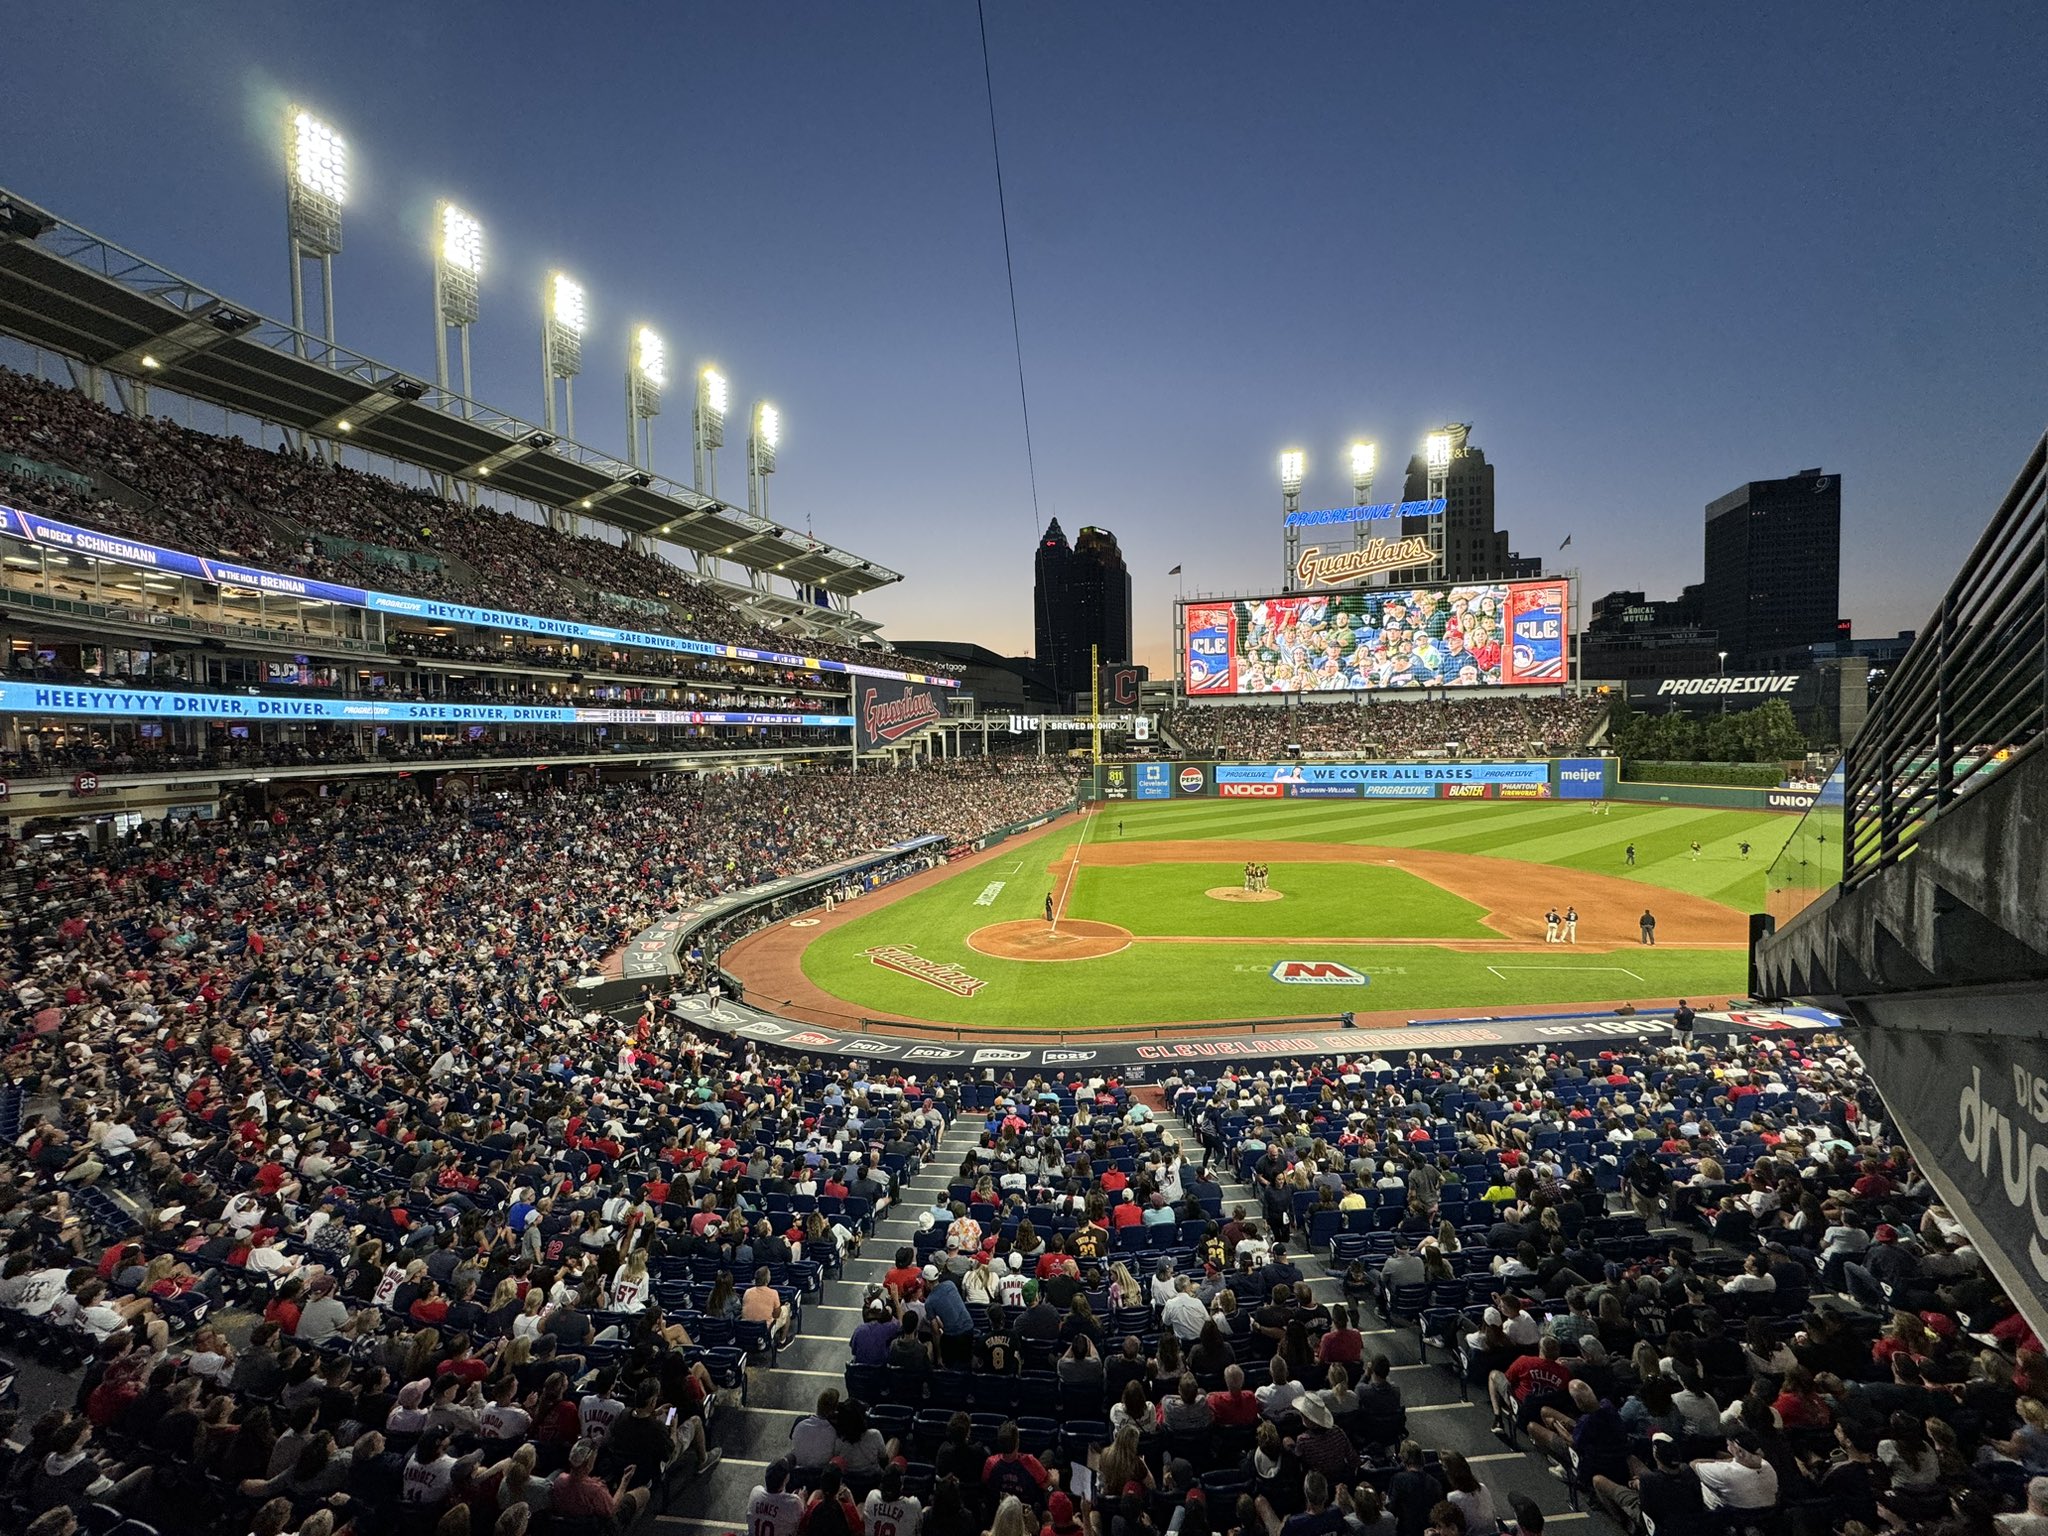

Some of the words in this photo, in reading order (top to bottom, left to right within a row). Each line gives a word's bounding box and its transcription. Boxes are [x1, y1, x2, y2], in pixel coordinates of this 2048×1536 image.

[1284, 503, 1395, 528] PROGRESSIVE
[1396, 498, 1448, 518] FIELD
[37, 526, 50, 538] ON
[50, 529, 73, 544] DECK
[76, 533, 157, 563] SCHNEEMANN
[1296, 537, 1437, 589] Guardians
[226, 572, 240, 582] THE
[240, 574, 258, 585] HOLE
[260, 576, 305, 593] BRENNAN
[1623, 614, 1655, 623] MUTUAL
[428, 604, 476, 620] HEYYY
[482, 612, 534, 630] DRIVER,
[537, 617, 584, 635] DRIVER.
[620, 633, 642, 643] SAFE
[645, 636, 680, 649] DRIVER,
[681, 642, 712, 653] DRIVER!
[1516, 620, 1558, 639] CLE
[1193, 637, 1226, 655] CLE
[937, 662, 967, 672] ortgage
[1114, 669, 1137, 705] C
[1657, 676, 1800, 696] PROGRESSIVE
[36, 688, 163, 710] HEEEYYYYY
[173, 697, 249, 716] DRIVER,
[258, 701, 331, 715] DRIVER.
[409, 706, 447, 718] SAFE
[452, 707, 508, 720] DRIVER,
[513, 708, 562, 719] DRIVER!
[863, 686, 942, 744] Guardians
[1009, 715, 1039, 734] Lite
[1051, 722, 1086, 730] BREWED
[1097, 722, 1117, 730] OHIO
[80, 778, 96, 789] 25
[1109, 771, 1122, 780] 811
[1314, 770, 1335, 779] WE
[1340, 770, 1388, 779] COVER
[1393, 770, 1420, 779] ALL
[1425, 770, 1473, 779] BASES
[1485, 770, 1534, 778] PROGRESSIVE
[1561, 768, 1602, 783] meijer
[1224, 785, 1278, 795] NOCO
[1366, 786, 1431, 795] PROGRESSIVE
[1449, 785, 1485, 796] BLASTER
[1285, 976, 1362, 984] Marathon
[1535, 1025, 1592, 1036] EST.
[1582, 1019, 1675, 1034] 1901
[851, 1042, 888, 1051] 2017
[1136, 1038, 1319, 1059] CLEVELAND
[1322, 1027, 1504, 1052] GUARDIANS
[1047, 1052, 1088, 1060] 2022
[545, 1240, 564, 1260] 12
[376, 1278, 393, 1300] 12
[617, 1284, 639, 1304] 57
[1009, 1293, 1021, 1307] 11
[1649, 1318, 1665, 1334] 11
[992, 1347, 1004, 1369] 8
[1529, 1369, 1562, 1387] FELLER
[584, 1409, 614, 1426] LINDOR
[756, 1502, 779, 1518] GOMES
[874, 1503, 904, 1522] FELLER
